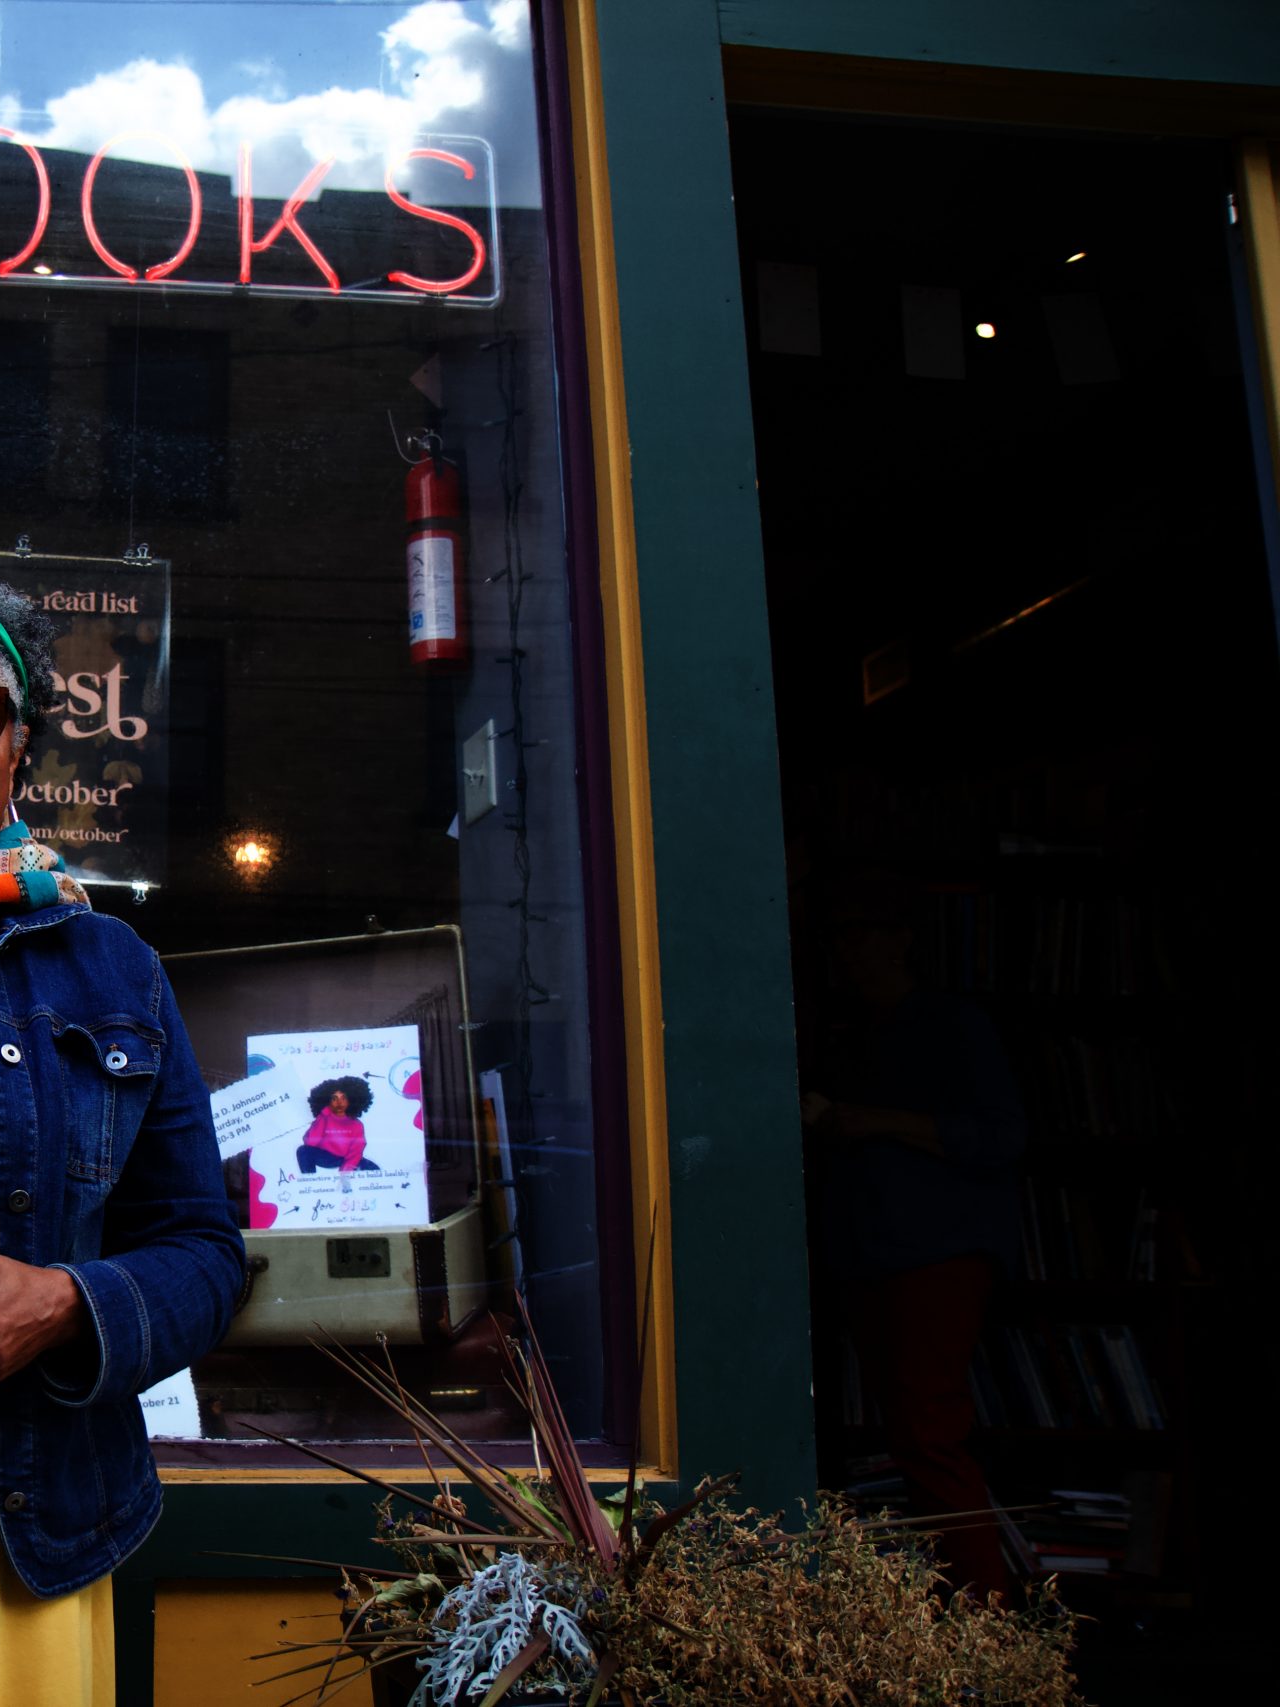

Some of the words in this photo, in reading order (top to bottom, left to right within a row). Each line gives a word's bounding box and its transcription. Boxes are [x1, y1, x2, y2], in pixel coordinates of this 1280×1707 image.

[101, 592, 139, 614] list
[232, 1091, 267, 1111] Johnson
[215, 1117, 243, 1132] urday,
[243, 1099, 277, 1119] October
[279, 1092, 290, 1102] 14
[236, 1123, 251, 1136] PM
[142, 1399, 165, 1408] ober
[168, 1396, 180, 1405] 21
